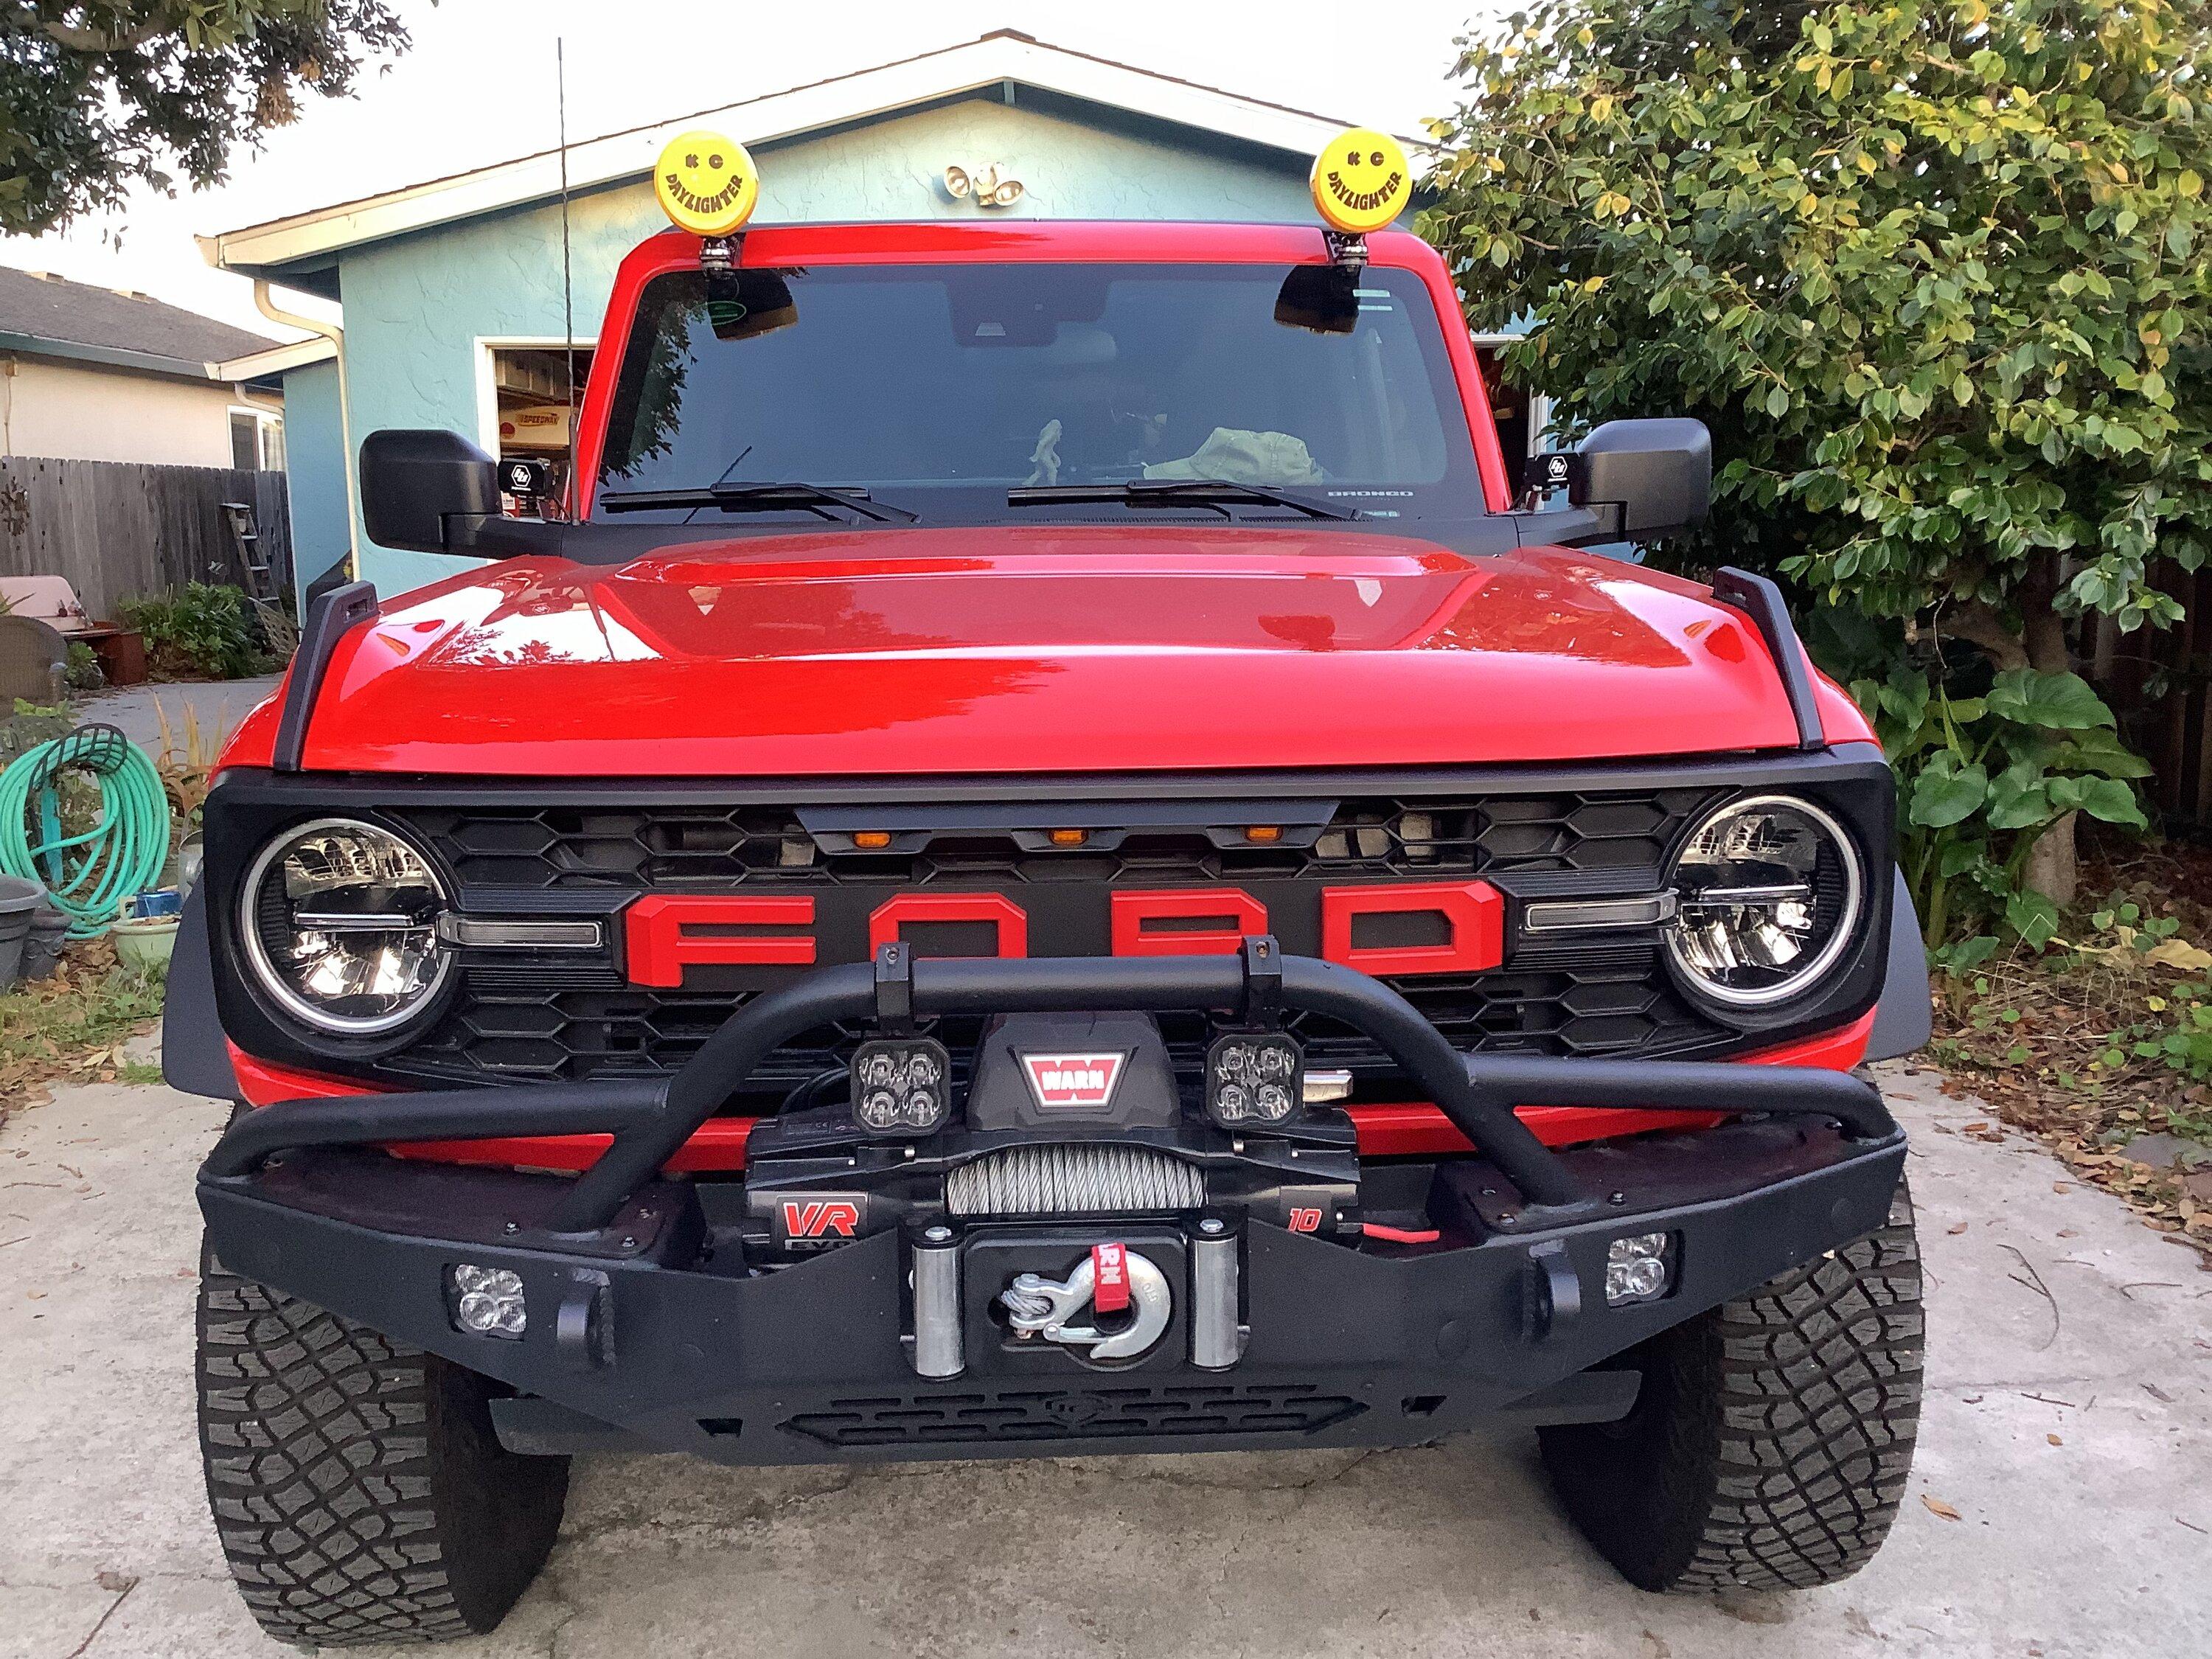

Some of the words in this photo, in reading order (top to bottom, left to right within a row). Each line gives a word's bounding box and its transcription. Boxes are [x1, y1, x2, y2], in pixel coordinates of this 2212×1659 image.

[666, 173, 742, 213] DAYLIGHTER
[1328, 171, 1402, 210] DAYLIGHTER
[627, 880, 1503, 989] FORD
[1041, 1070, 1105, 1091] WARN
[783, 1202, 859, 1237] VR
[1288, 1208, 1322, 1232] 10
